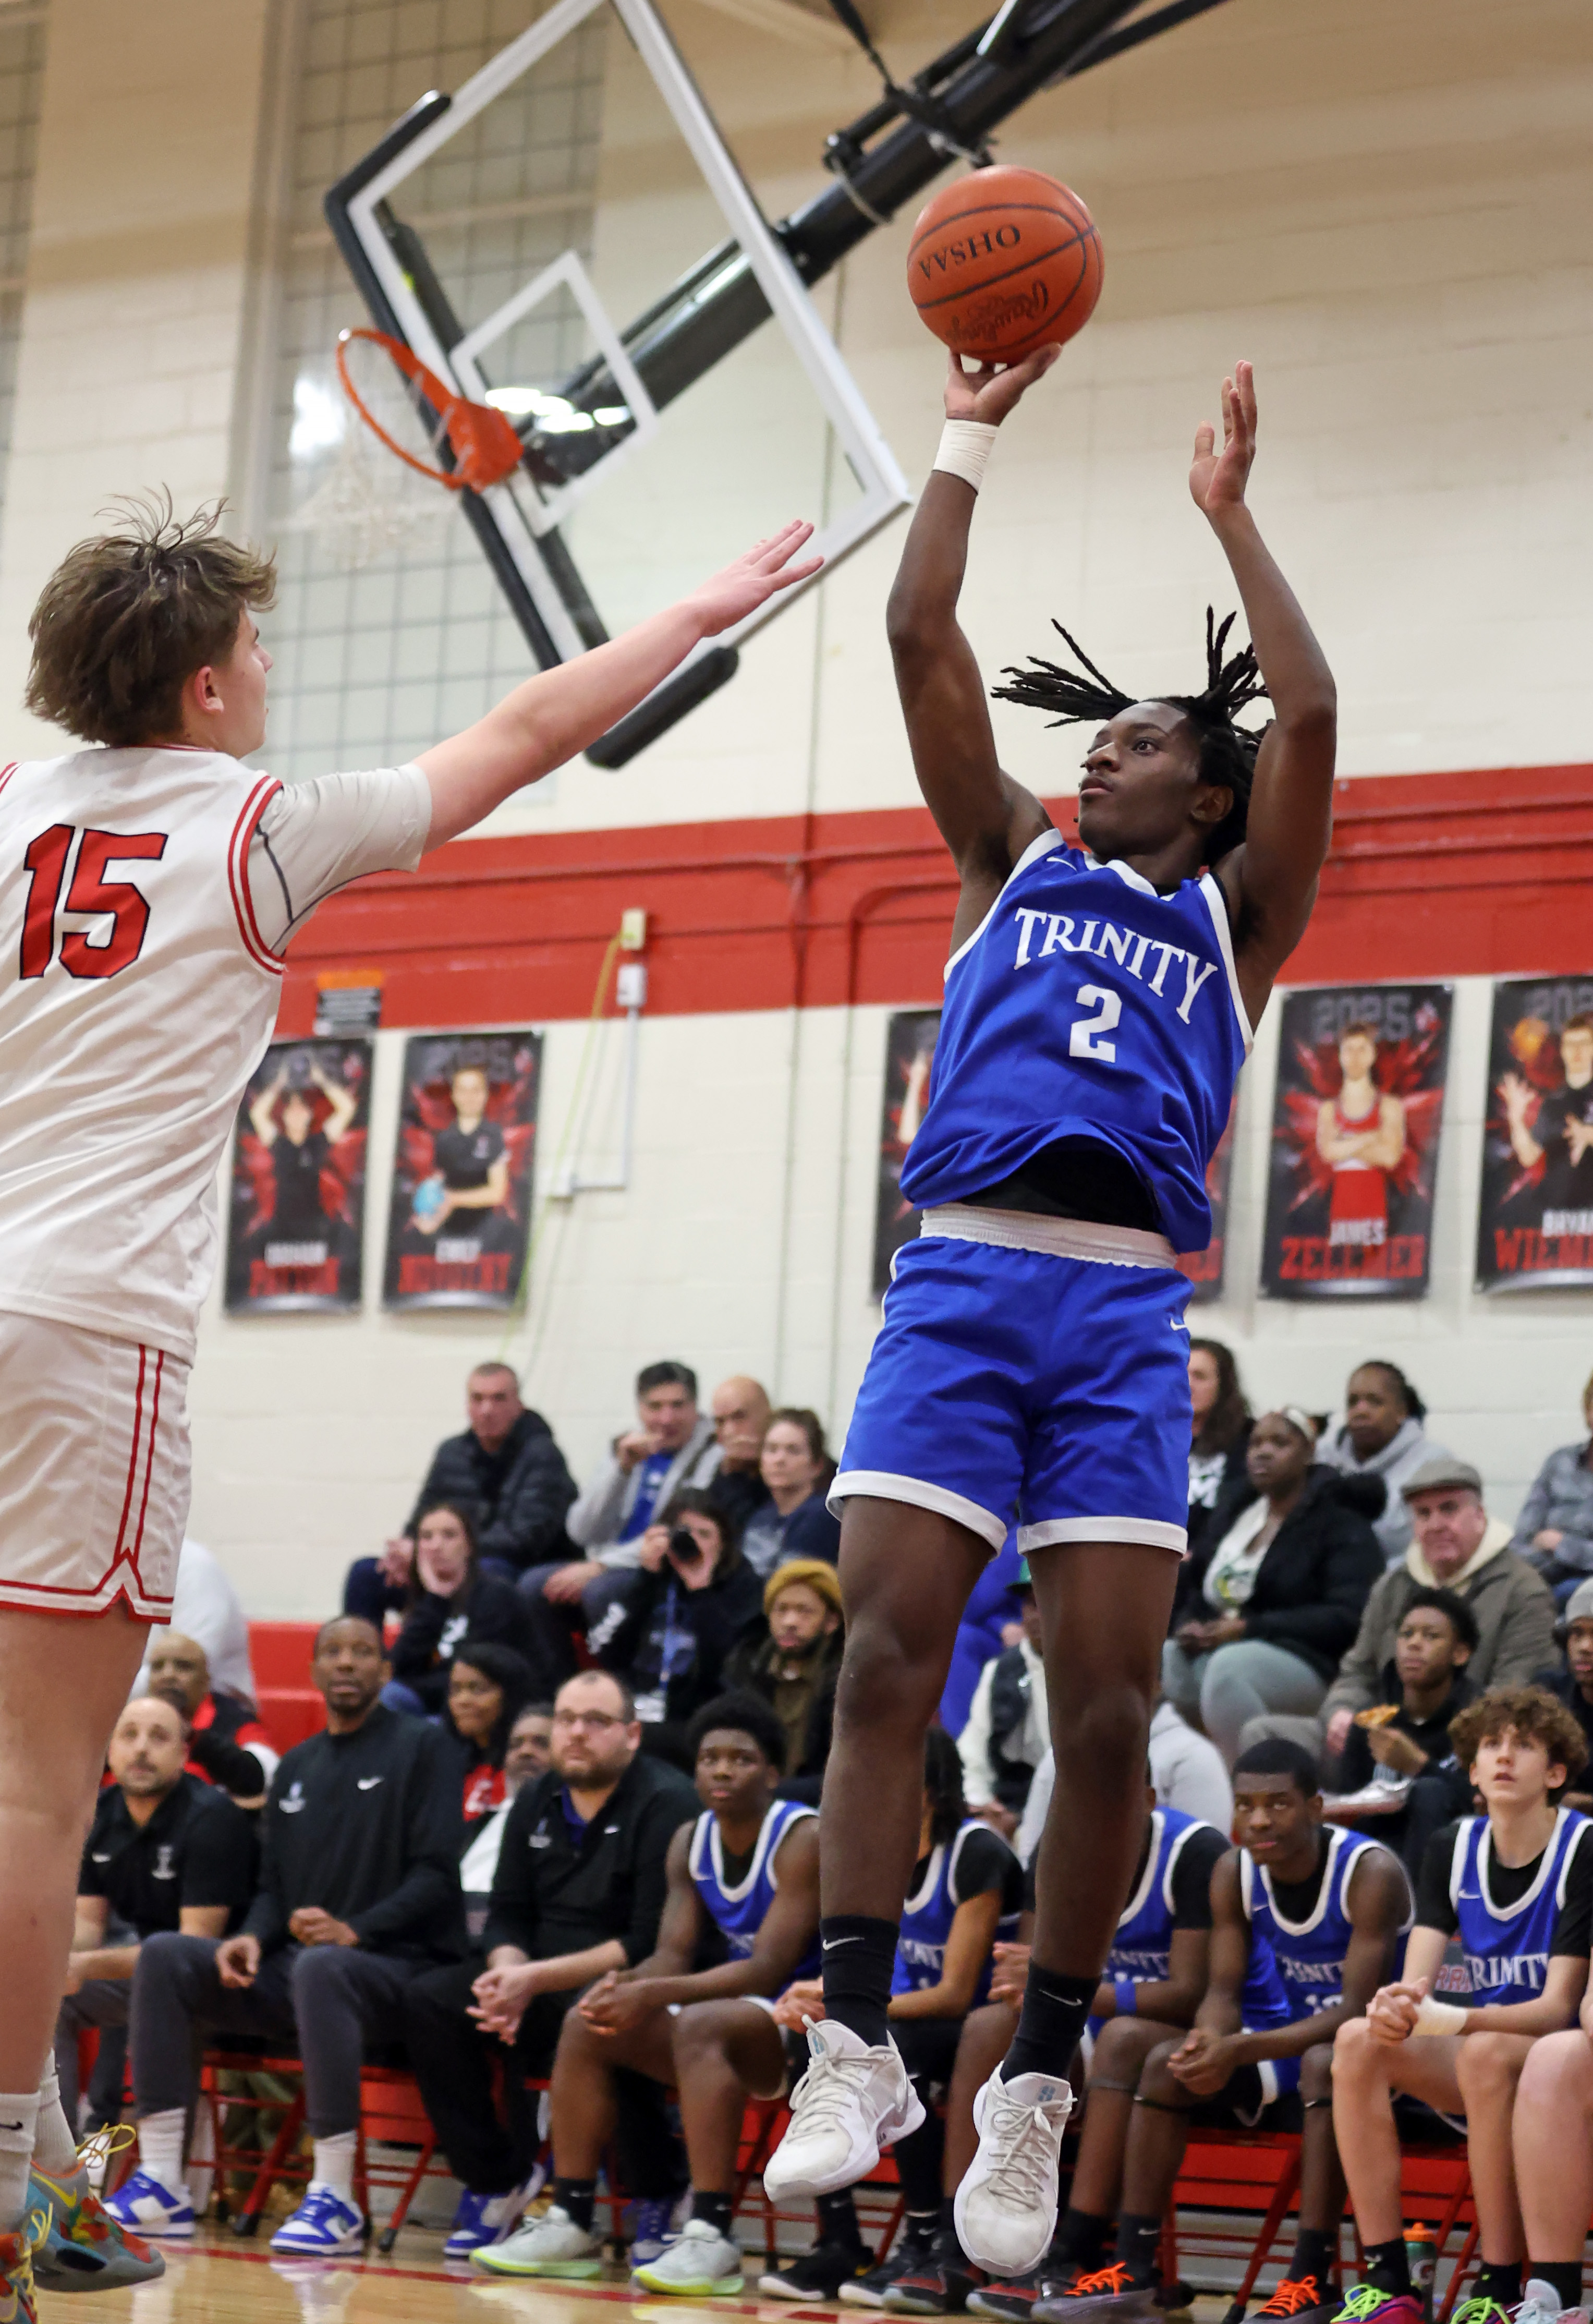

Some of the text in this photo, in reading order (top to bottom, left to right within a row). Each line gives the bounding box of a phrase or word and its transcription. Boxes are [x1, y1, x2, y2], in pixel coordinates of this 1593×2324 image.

[918, 224, 1021, 280] OHSAA
[19, 824, 169, 979] 15
[1014, 907, 1218, 1024] TRINITY
[1069, 983, 1122, 1063] 2
